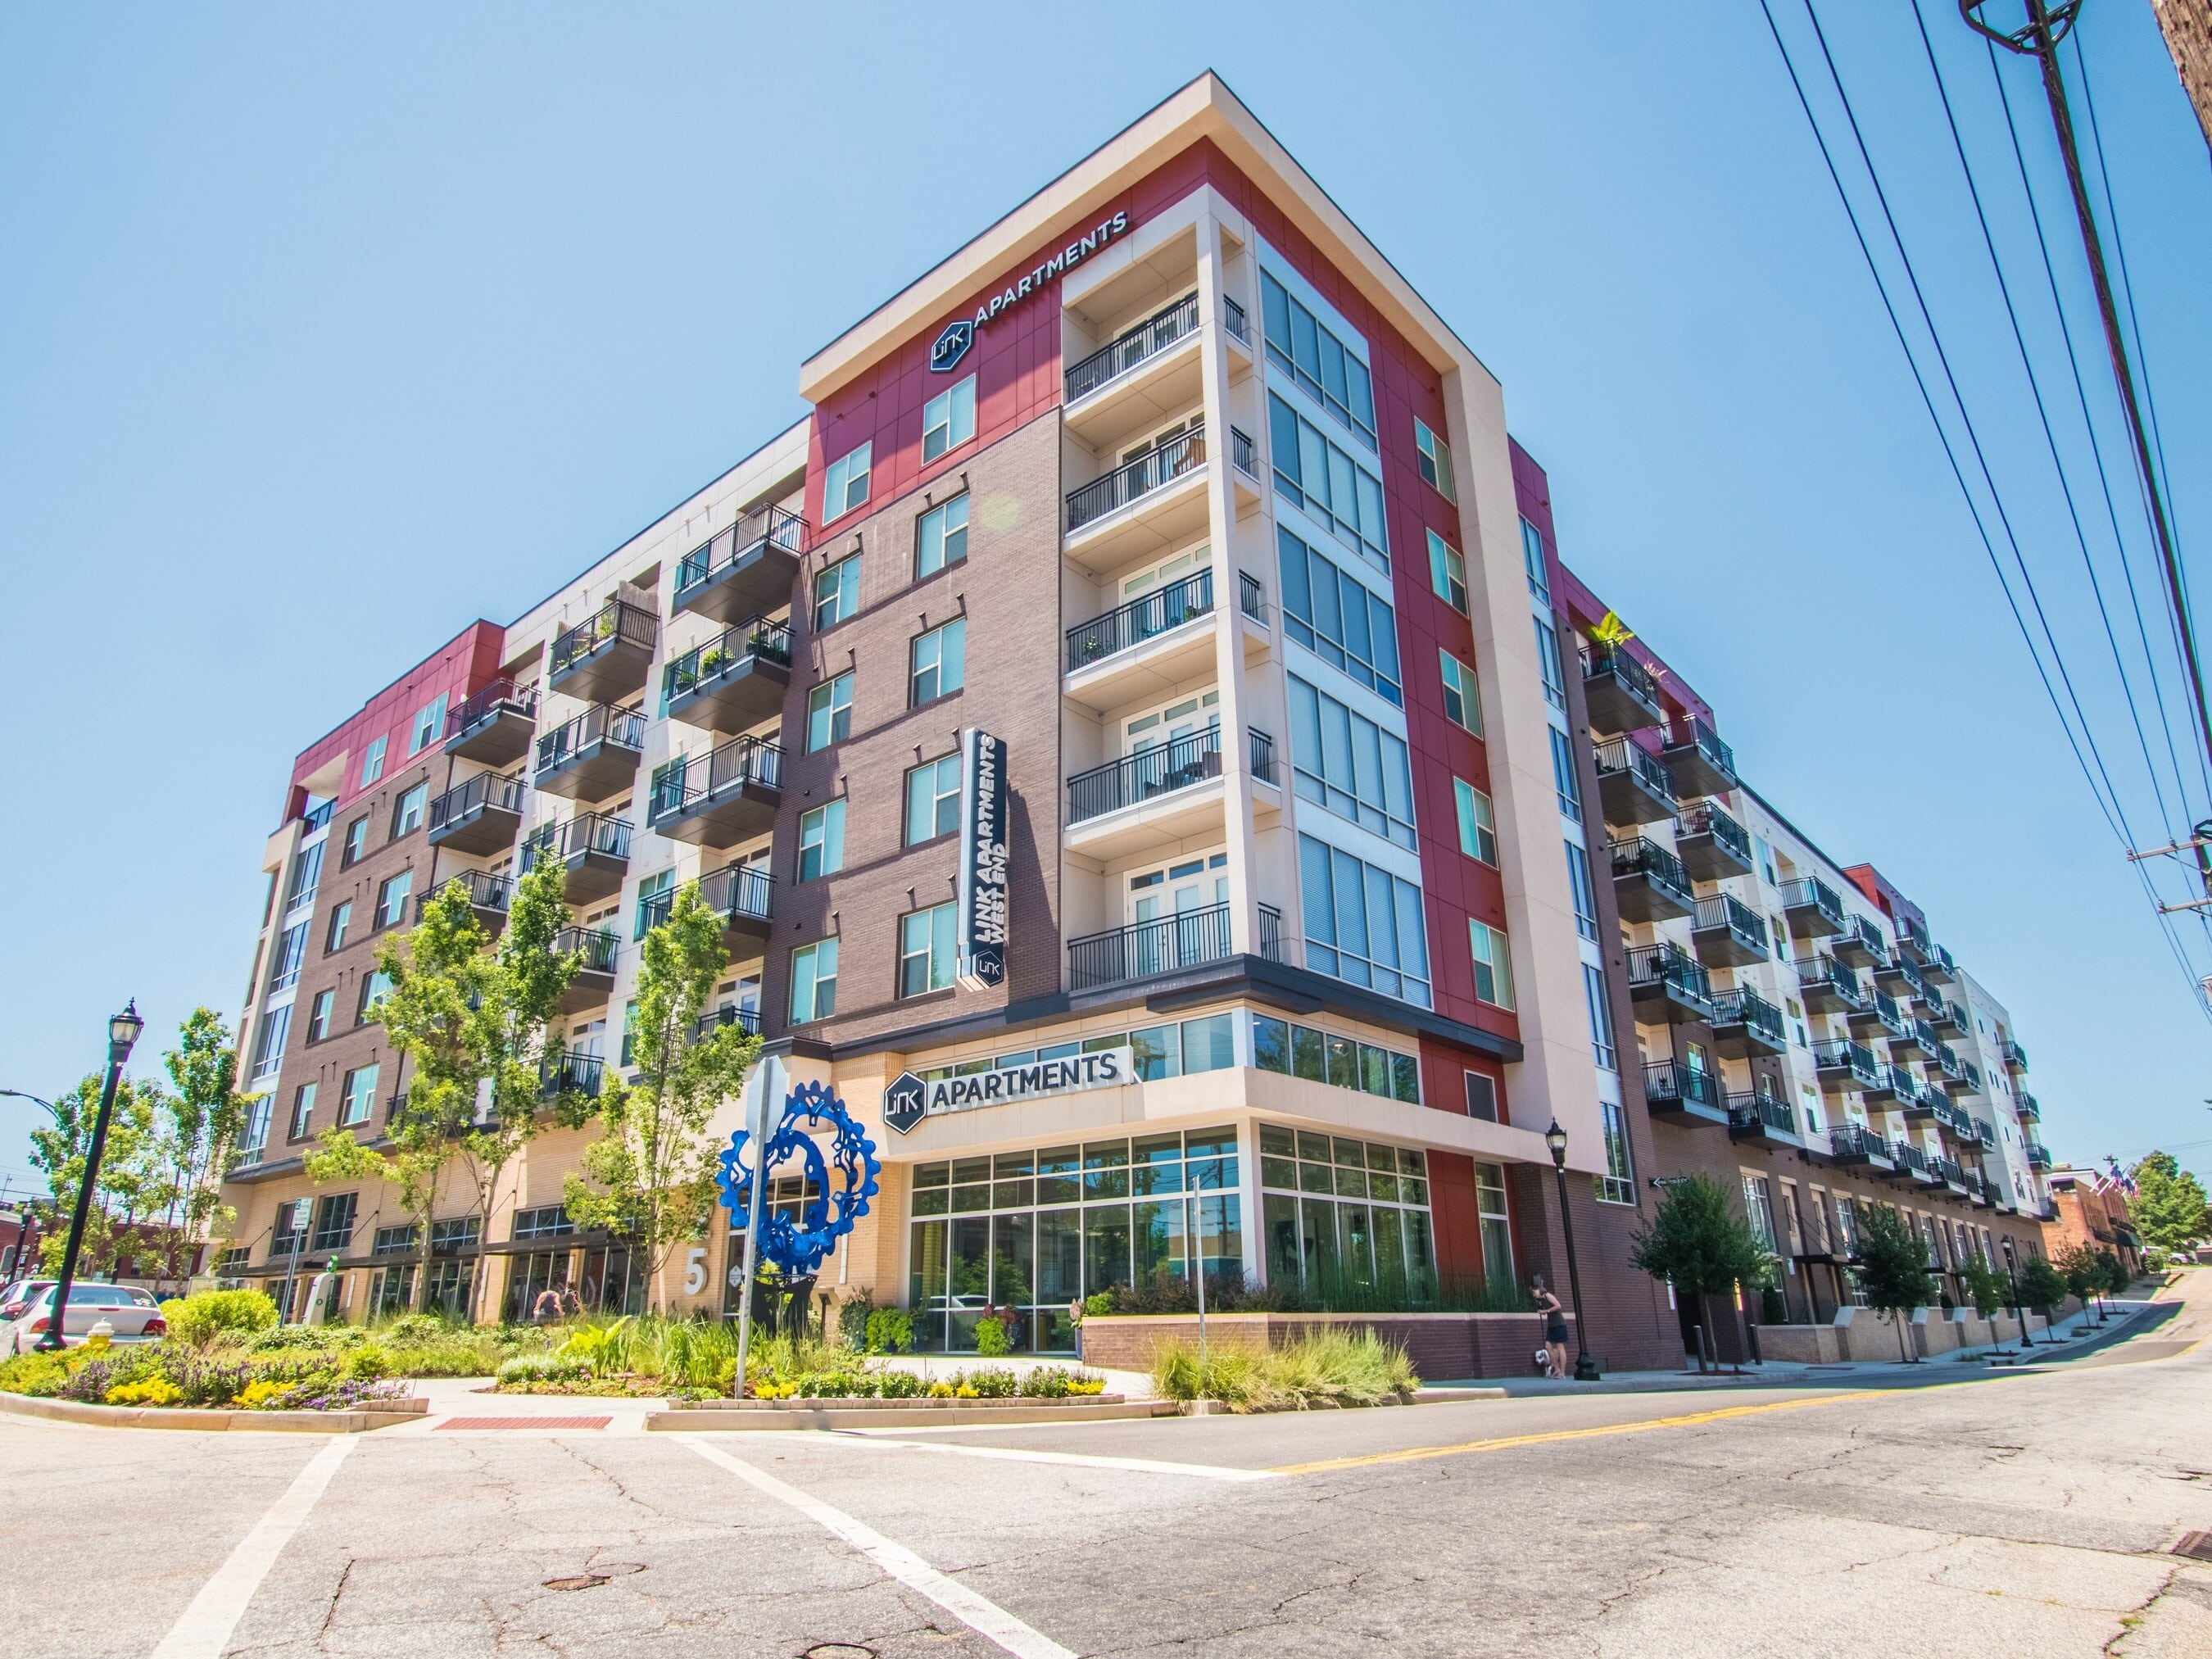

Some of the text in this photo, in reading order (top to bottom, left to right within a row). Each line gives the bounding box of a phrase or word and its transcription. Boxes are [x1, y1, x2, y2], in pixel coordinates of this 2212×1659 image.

[974, 211, 1127, 328] APARTMENTS
[975, 733, 995, 942] LINK APARTMENTS
[990, 843, 1006, 944] WEST END
[931, 1053, 1117, 1108] APARTMENTS
[683, 1247, 708, 1295] 5
